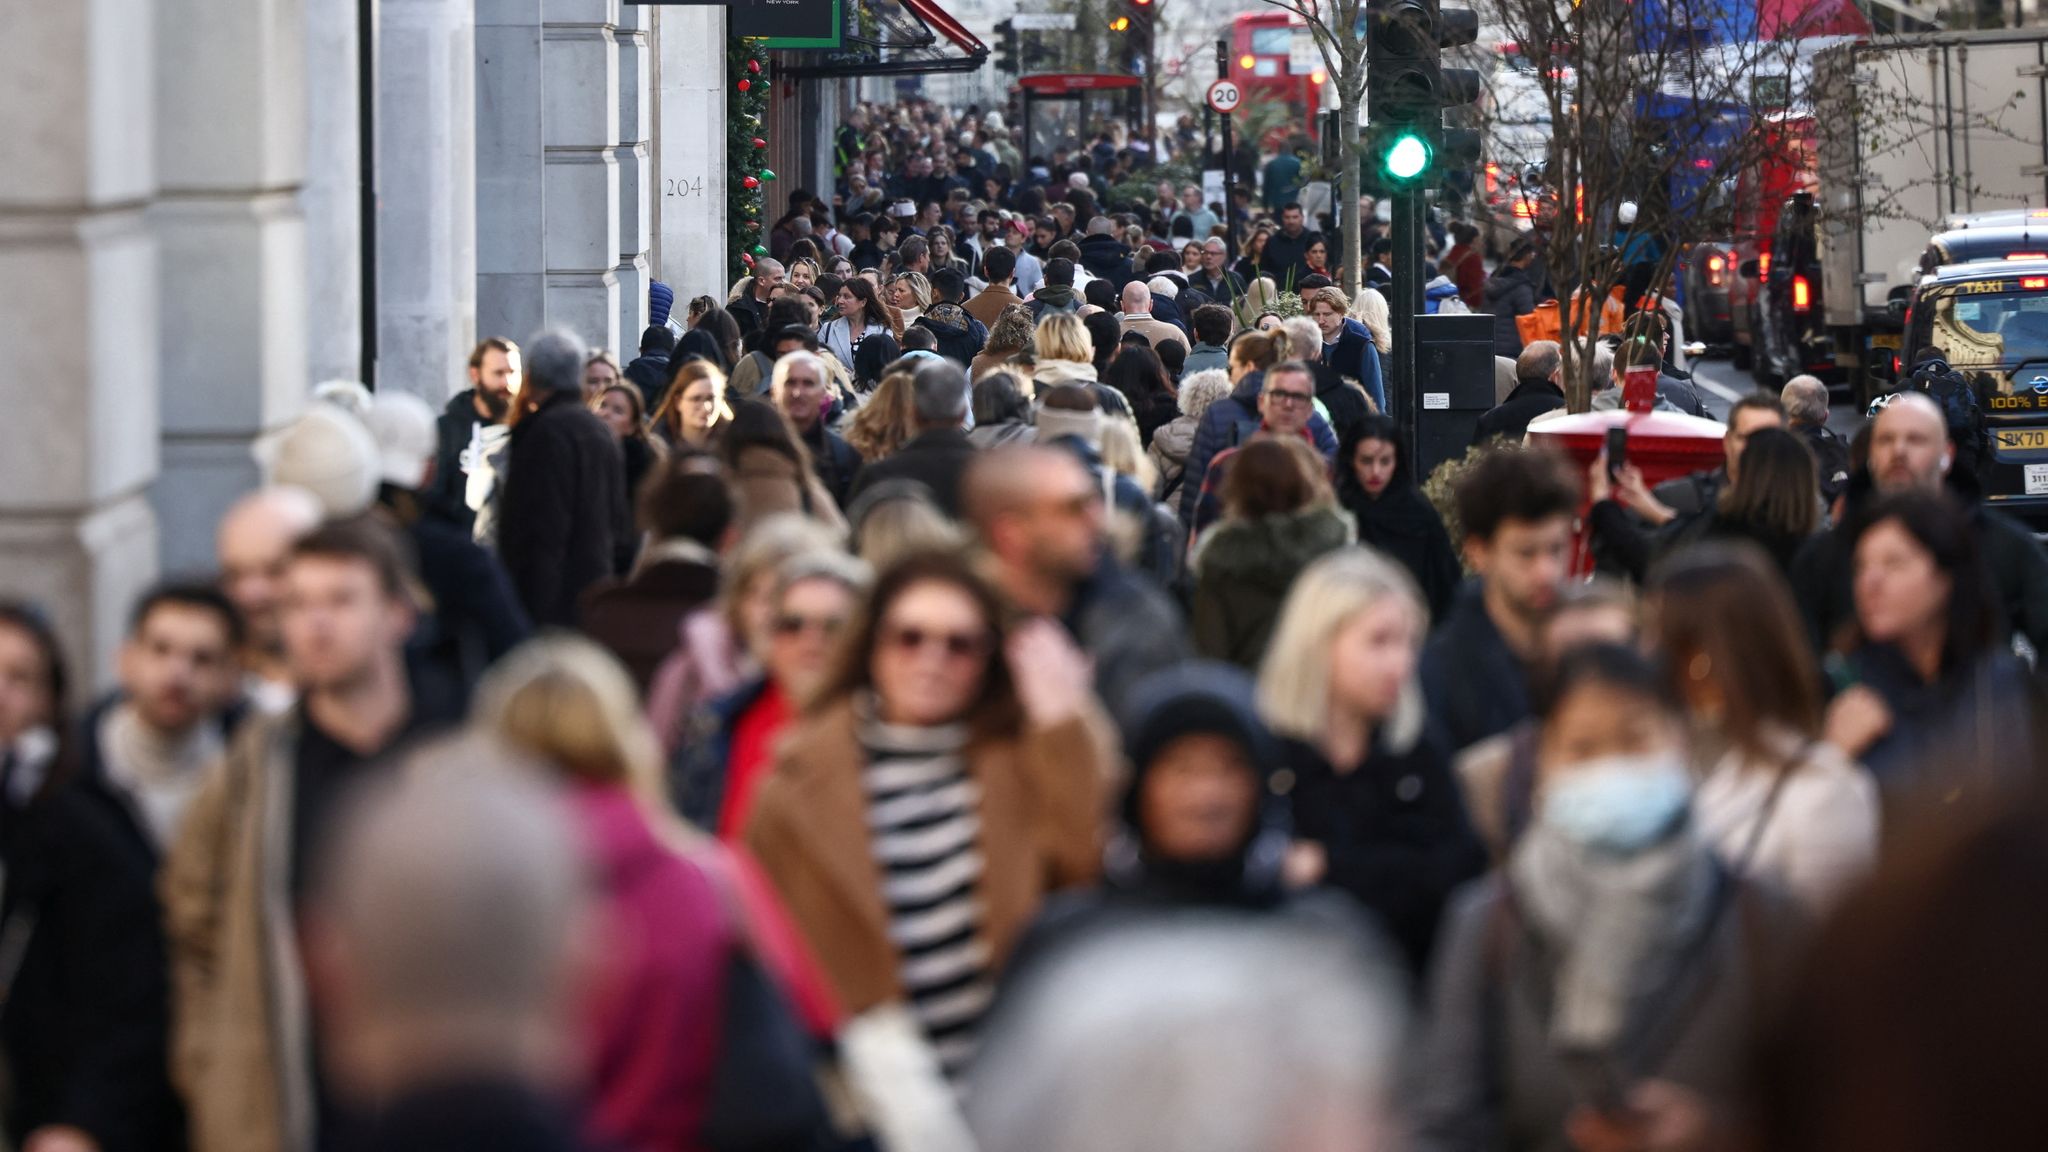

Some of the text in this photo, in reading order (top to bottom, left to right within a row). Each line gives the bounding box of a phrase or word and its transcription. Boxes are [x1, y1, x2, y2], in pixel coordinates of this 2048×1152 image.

[1215, 89, 1237, 102] 20
[666, 176, 703, 196] 204
[1966, 281, 2003, 293] TAXI
[1990, 397, 2031, 408] 100%
[2005, 432, 2044, 446] BK70
[2032, 475, 2048, 483] 311
